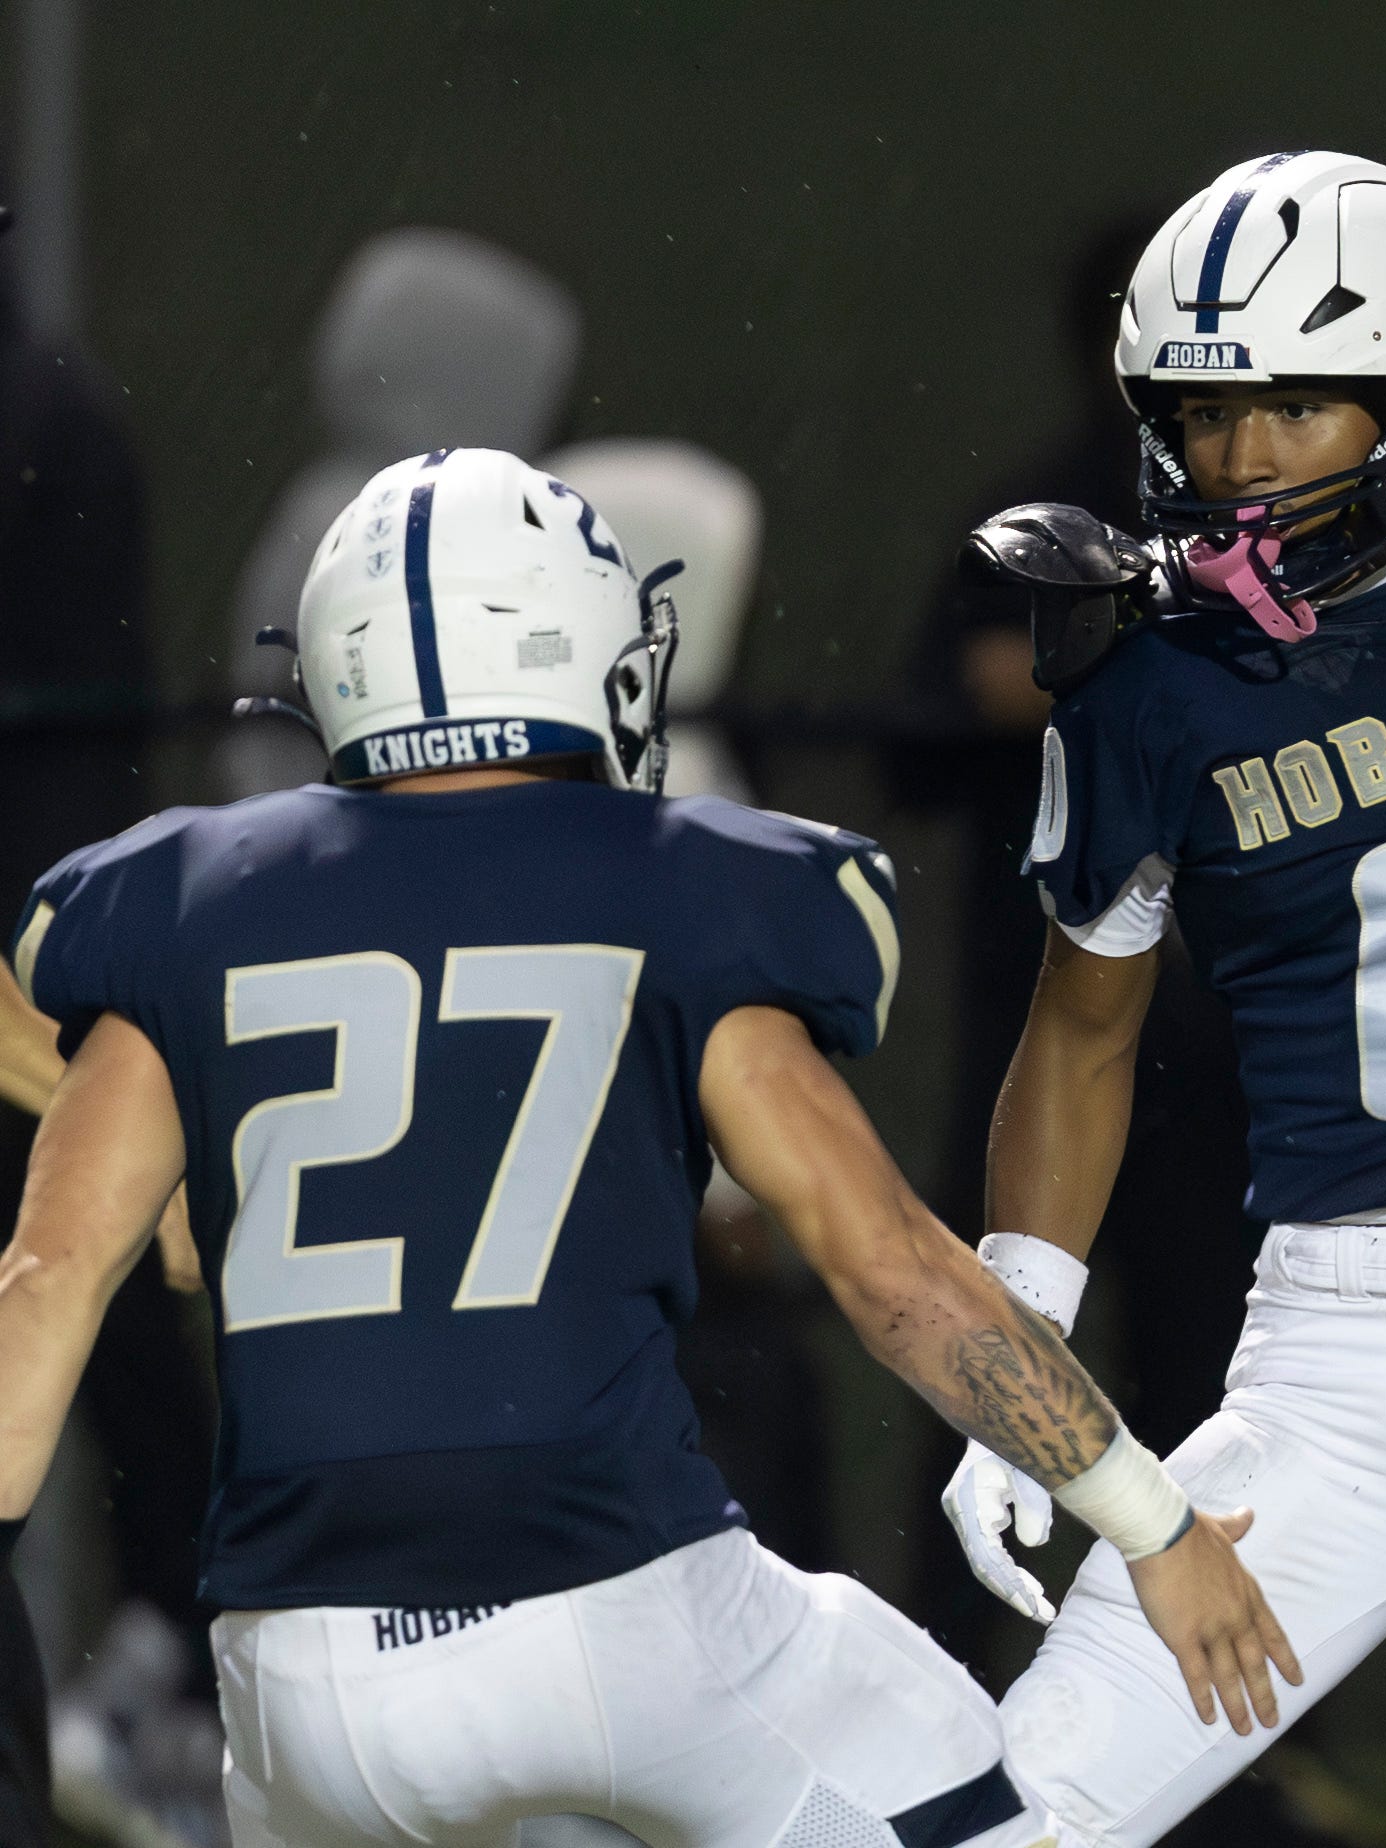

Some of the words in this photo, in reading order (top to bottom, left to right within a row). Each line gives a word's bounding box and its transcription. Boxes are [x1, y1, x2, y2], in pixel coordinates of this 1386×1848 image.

[1167, 344, 1237, 368] HOBAN
[363, 720, 531, 777] KNIGHTS
[222, 942, 646, 1335] 27
